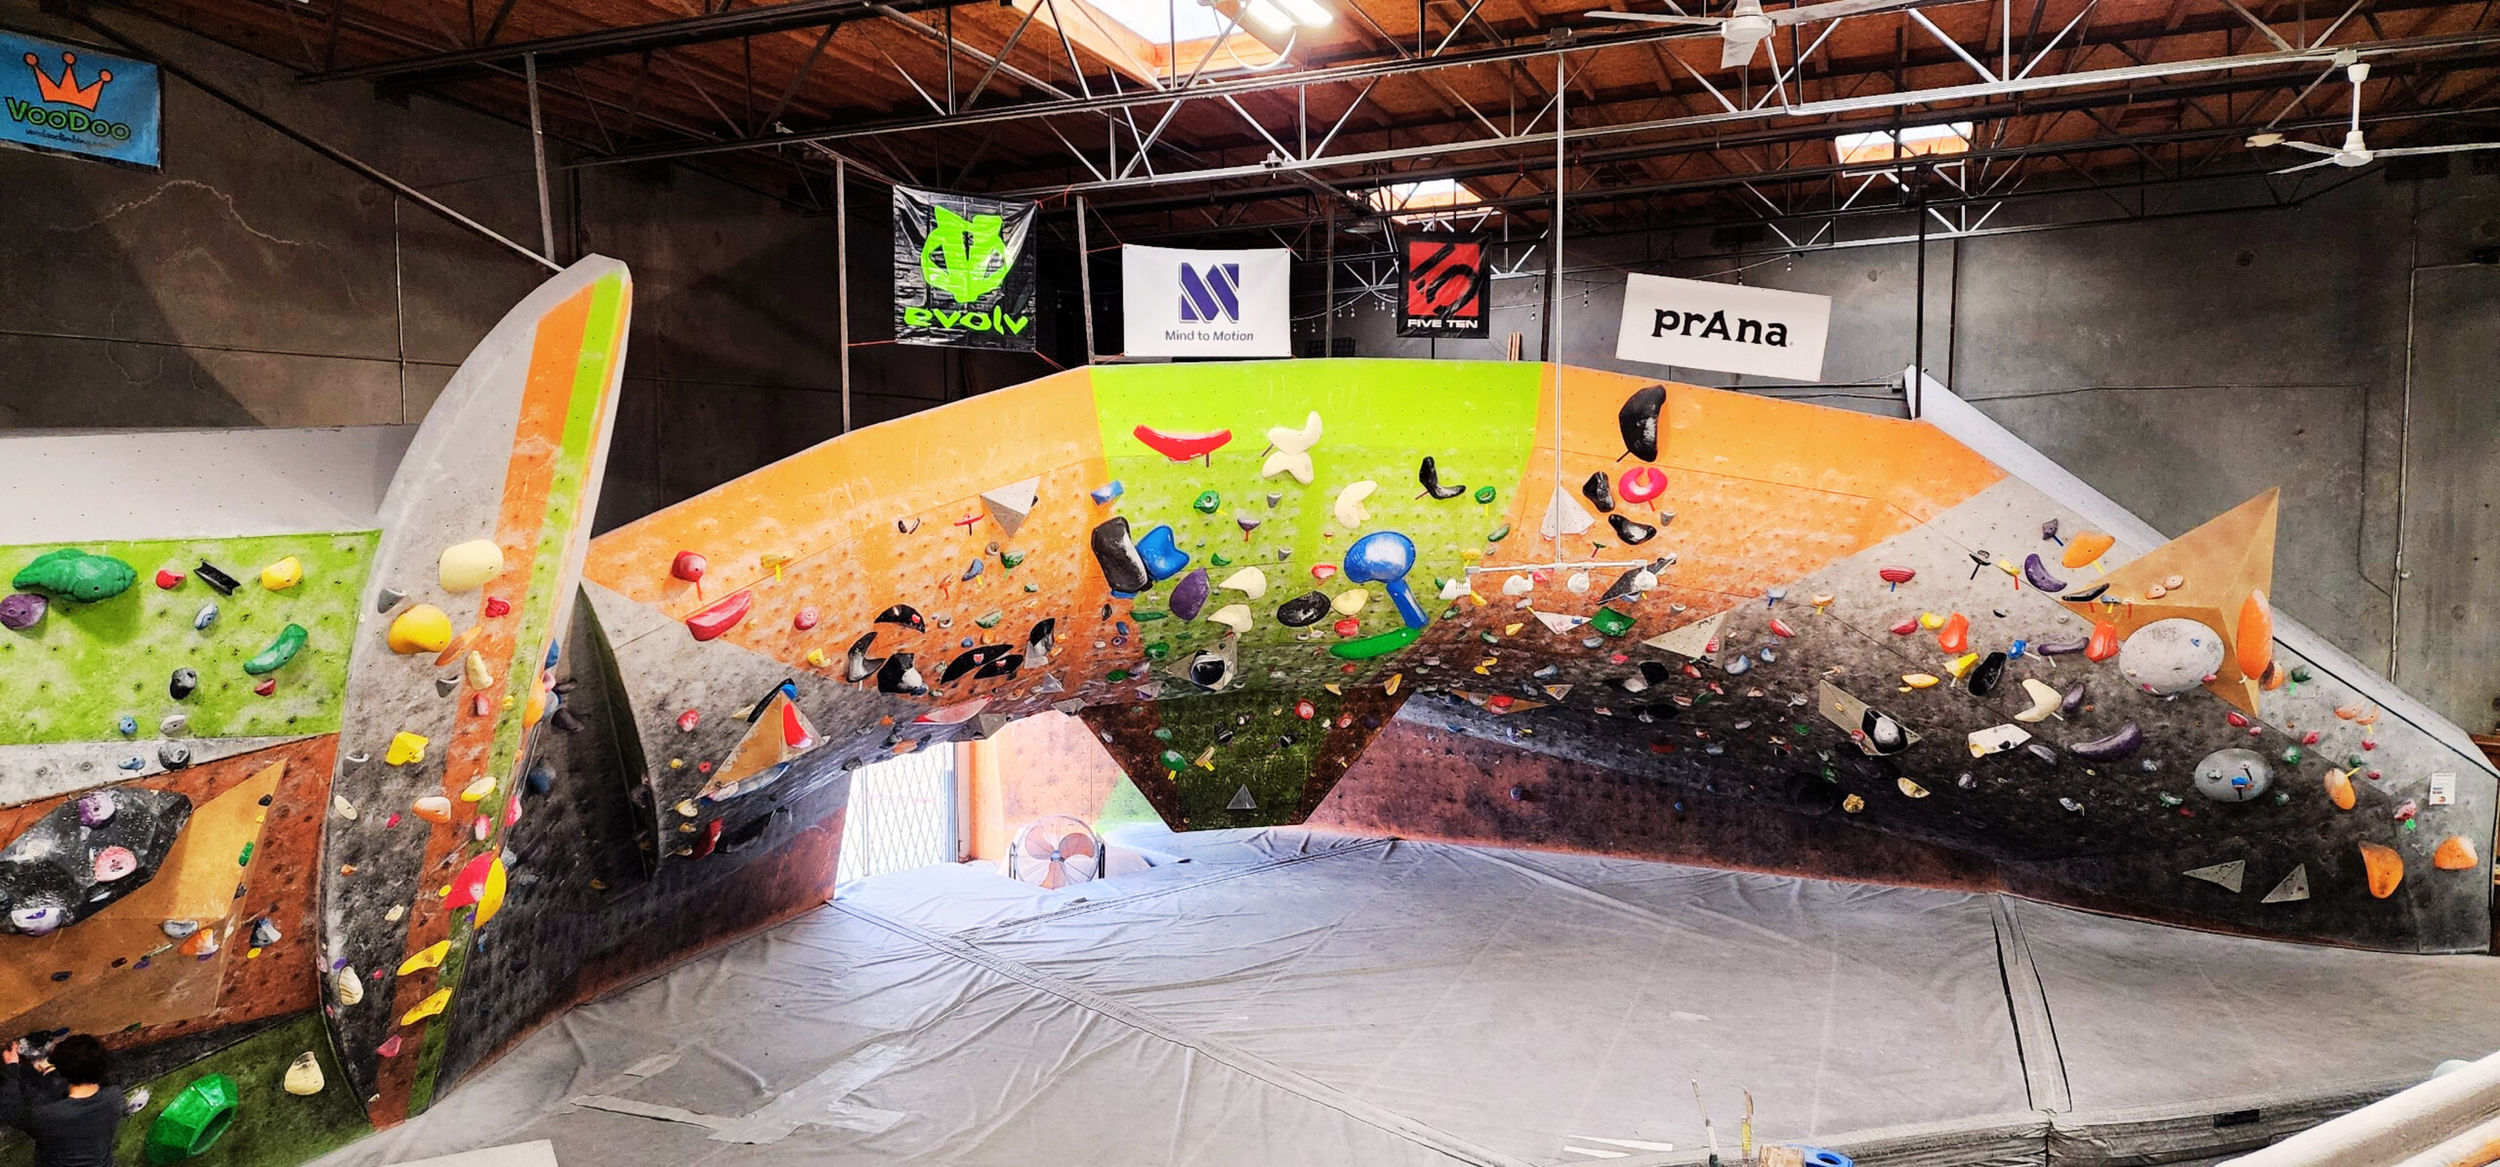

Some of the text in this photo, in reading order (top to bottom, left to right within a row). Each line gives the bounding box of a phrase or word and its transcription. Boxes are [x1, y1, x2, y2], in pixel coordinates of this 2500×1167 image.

[904, 305, 1029, 335] evolv
[1407, 319, 1479, 328] FIVE TEN
[1651, 308, 1788, 347] prAna
[1165, 330, 1254, 341] Mind to Motion
